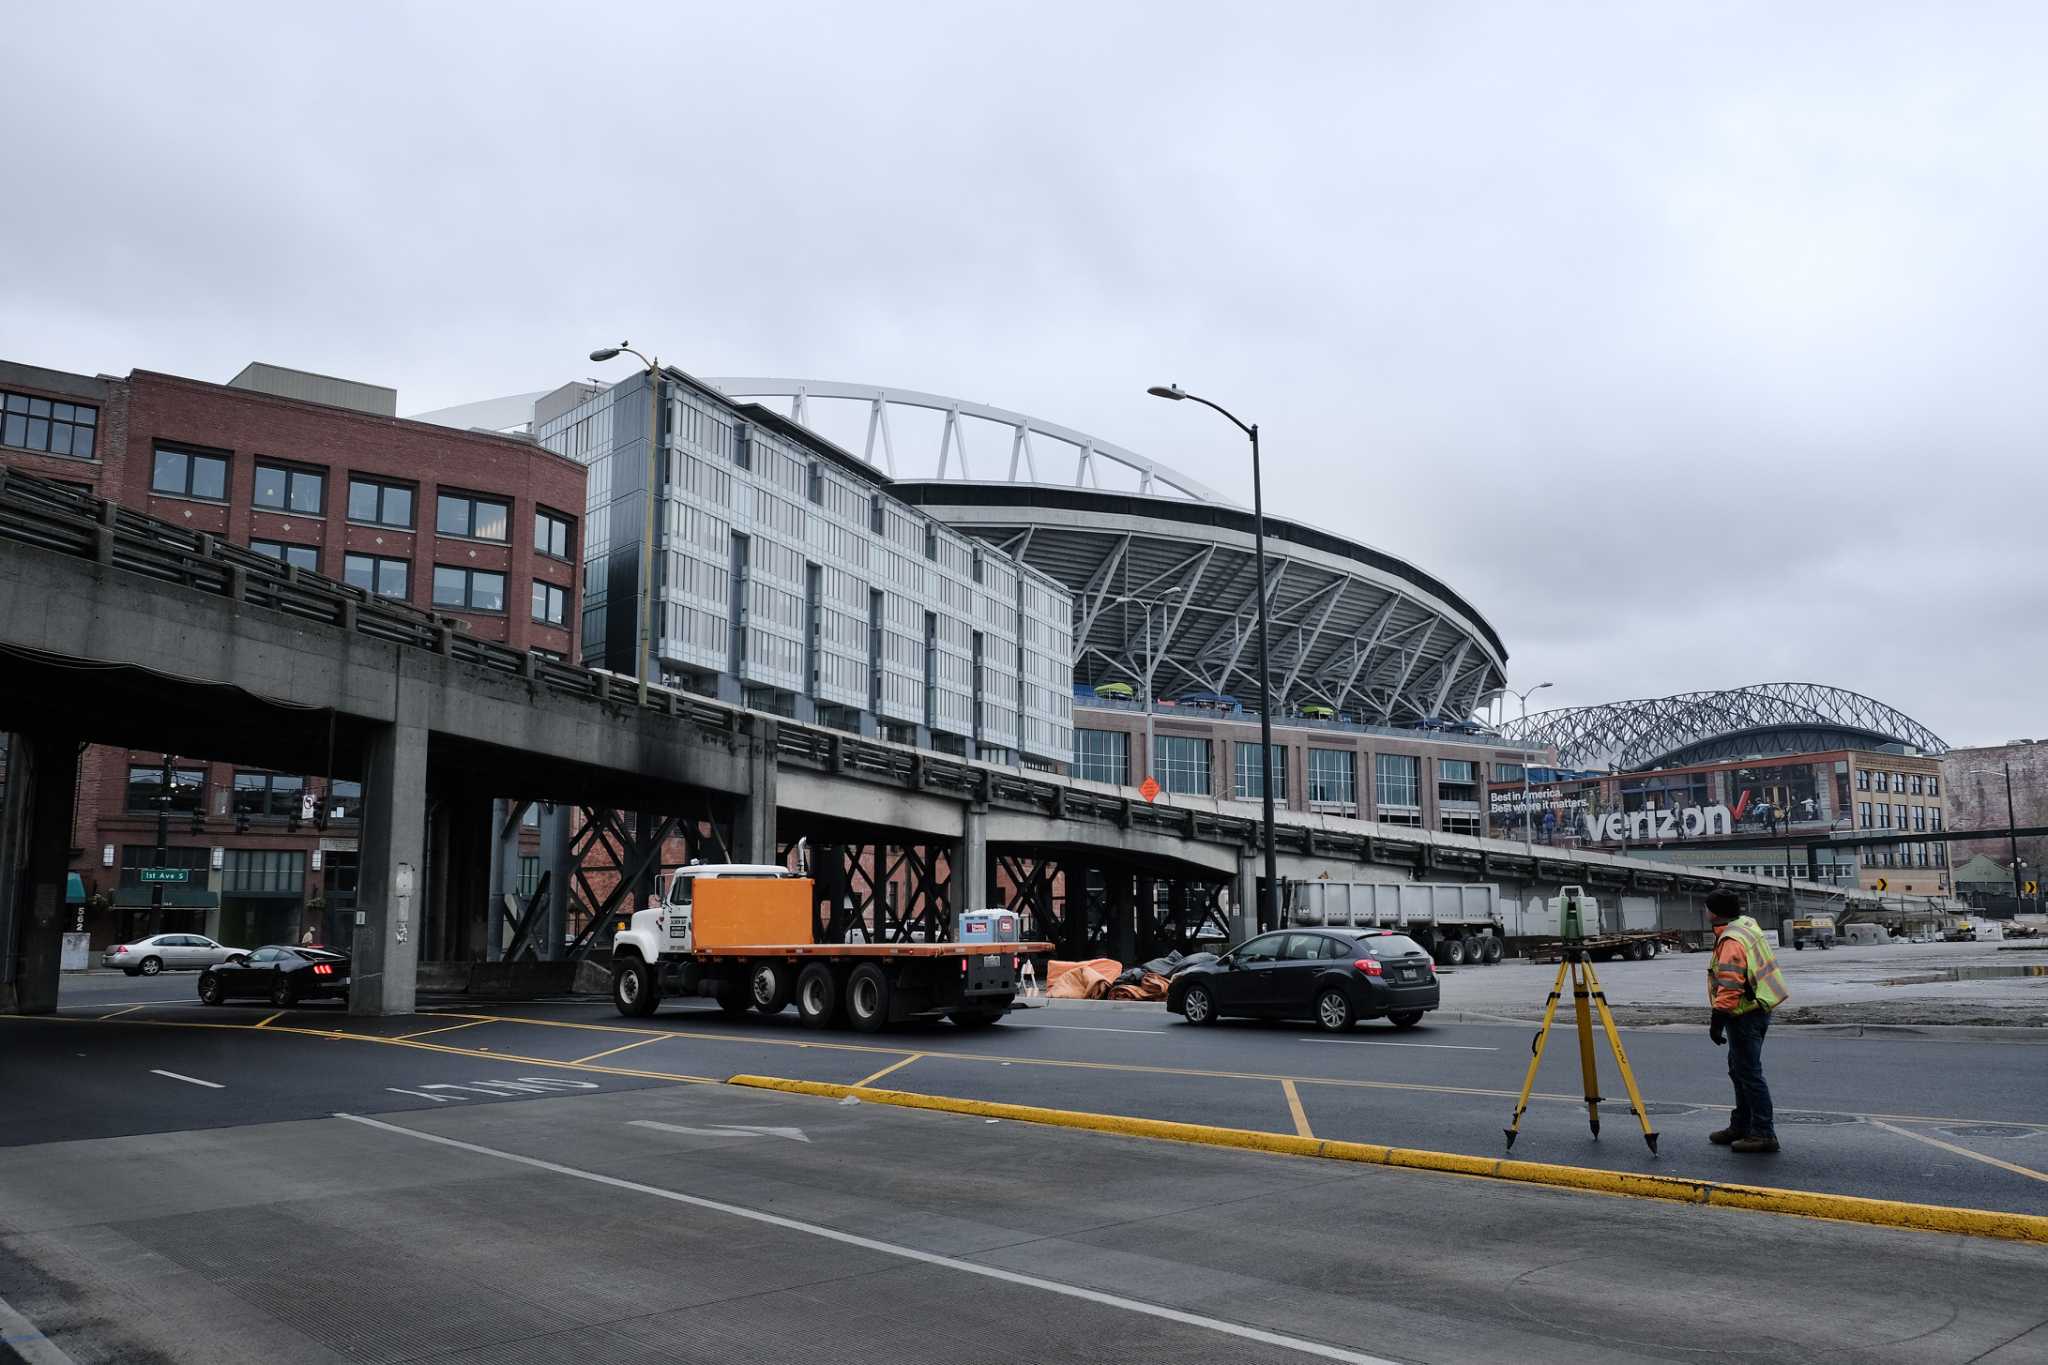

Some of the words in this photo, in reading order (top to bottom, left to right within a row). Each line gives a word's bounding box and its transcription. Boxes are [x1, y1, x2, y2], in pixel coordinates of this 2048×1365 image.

[1491, 792, 1511, 802] Best
[1512, 791, 1521, 801] in
[1522, 788, 1563, 800] America.
[1491, 803, 1512, 813] Best
[1550, 799, 1590, 809] matters.
[1586, 801, 1732, 841] verizon
[76, 907, 86, 931] 562
[385, 1077, 600, 1102] ONLY
